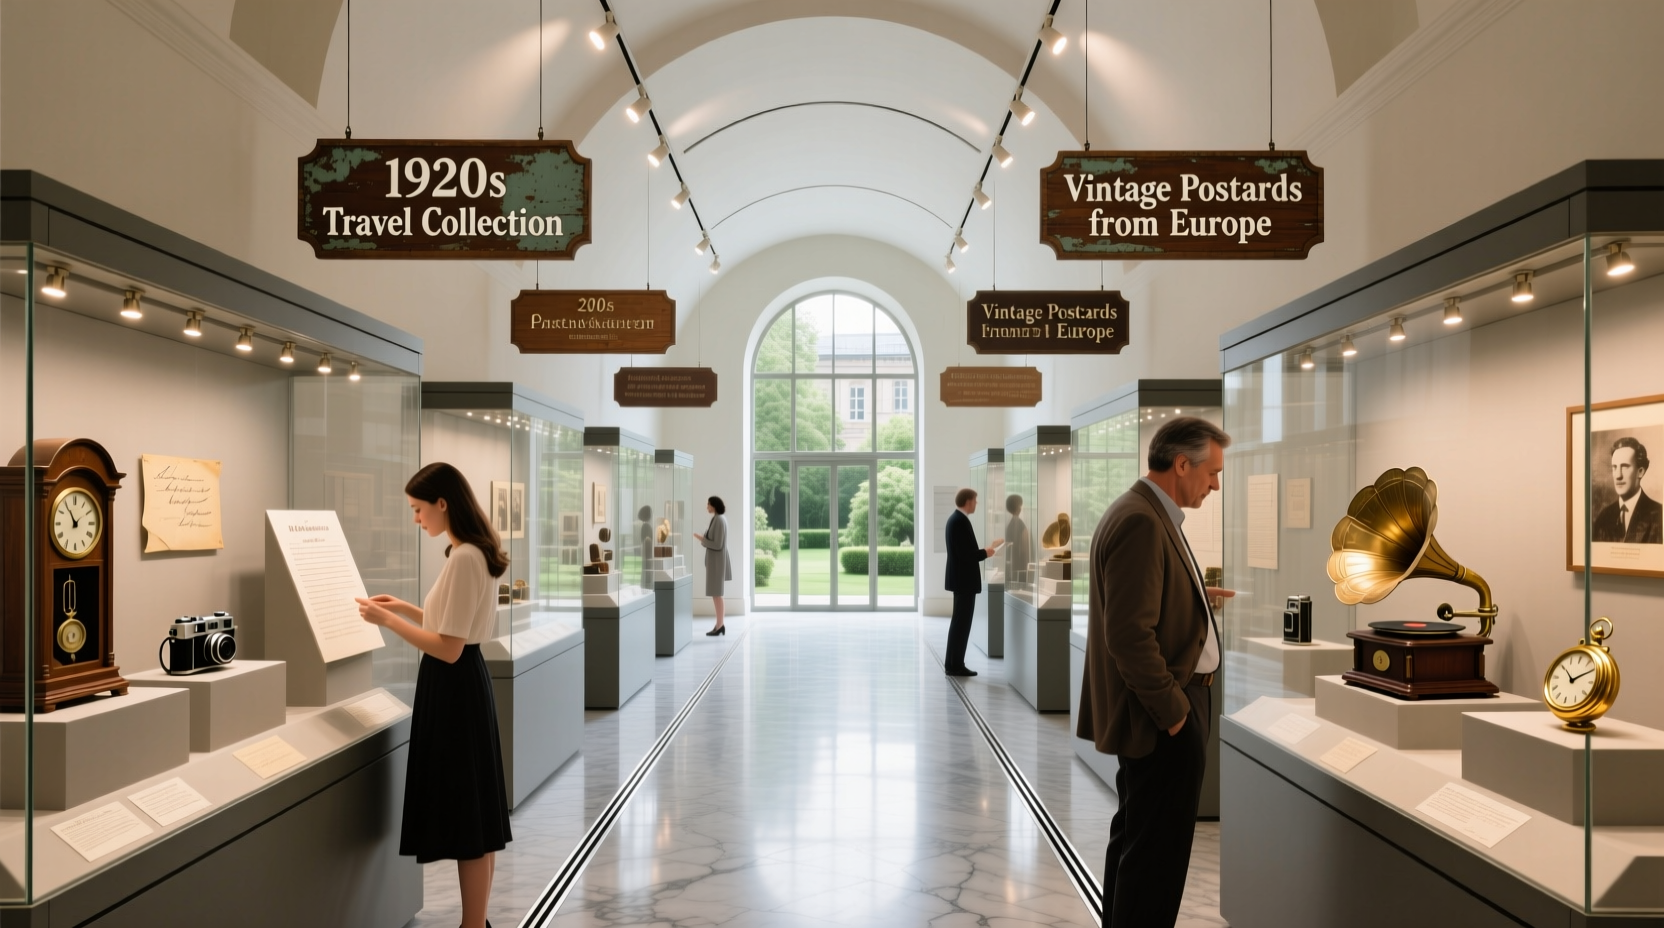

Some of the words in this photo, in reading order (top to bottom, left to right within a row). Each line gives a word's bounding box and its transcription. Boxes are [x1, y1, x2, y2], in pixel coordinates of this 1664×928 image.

[385, 157, 507, 198] 1920s
[1063, 173, 1172, 210] Vintage
[1180, 173, 1302, 202] Postards
[322, 206, 413, 236] Travel
[421, 206, 564, 237] Collection
[1088, 208, 1159, 237] from
[1169, 208, 1272, 244] Europe
[577, 297, 614, 313] 200s
[981, 303, 1043, 325] Vintage
[1056, 323, 1115, 344] Europe
